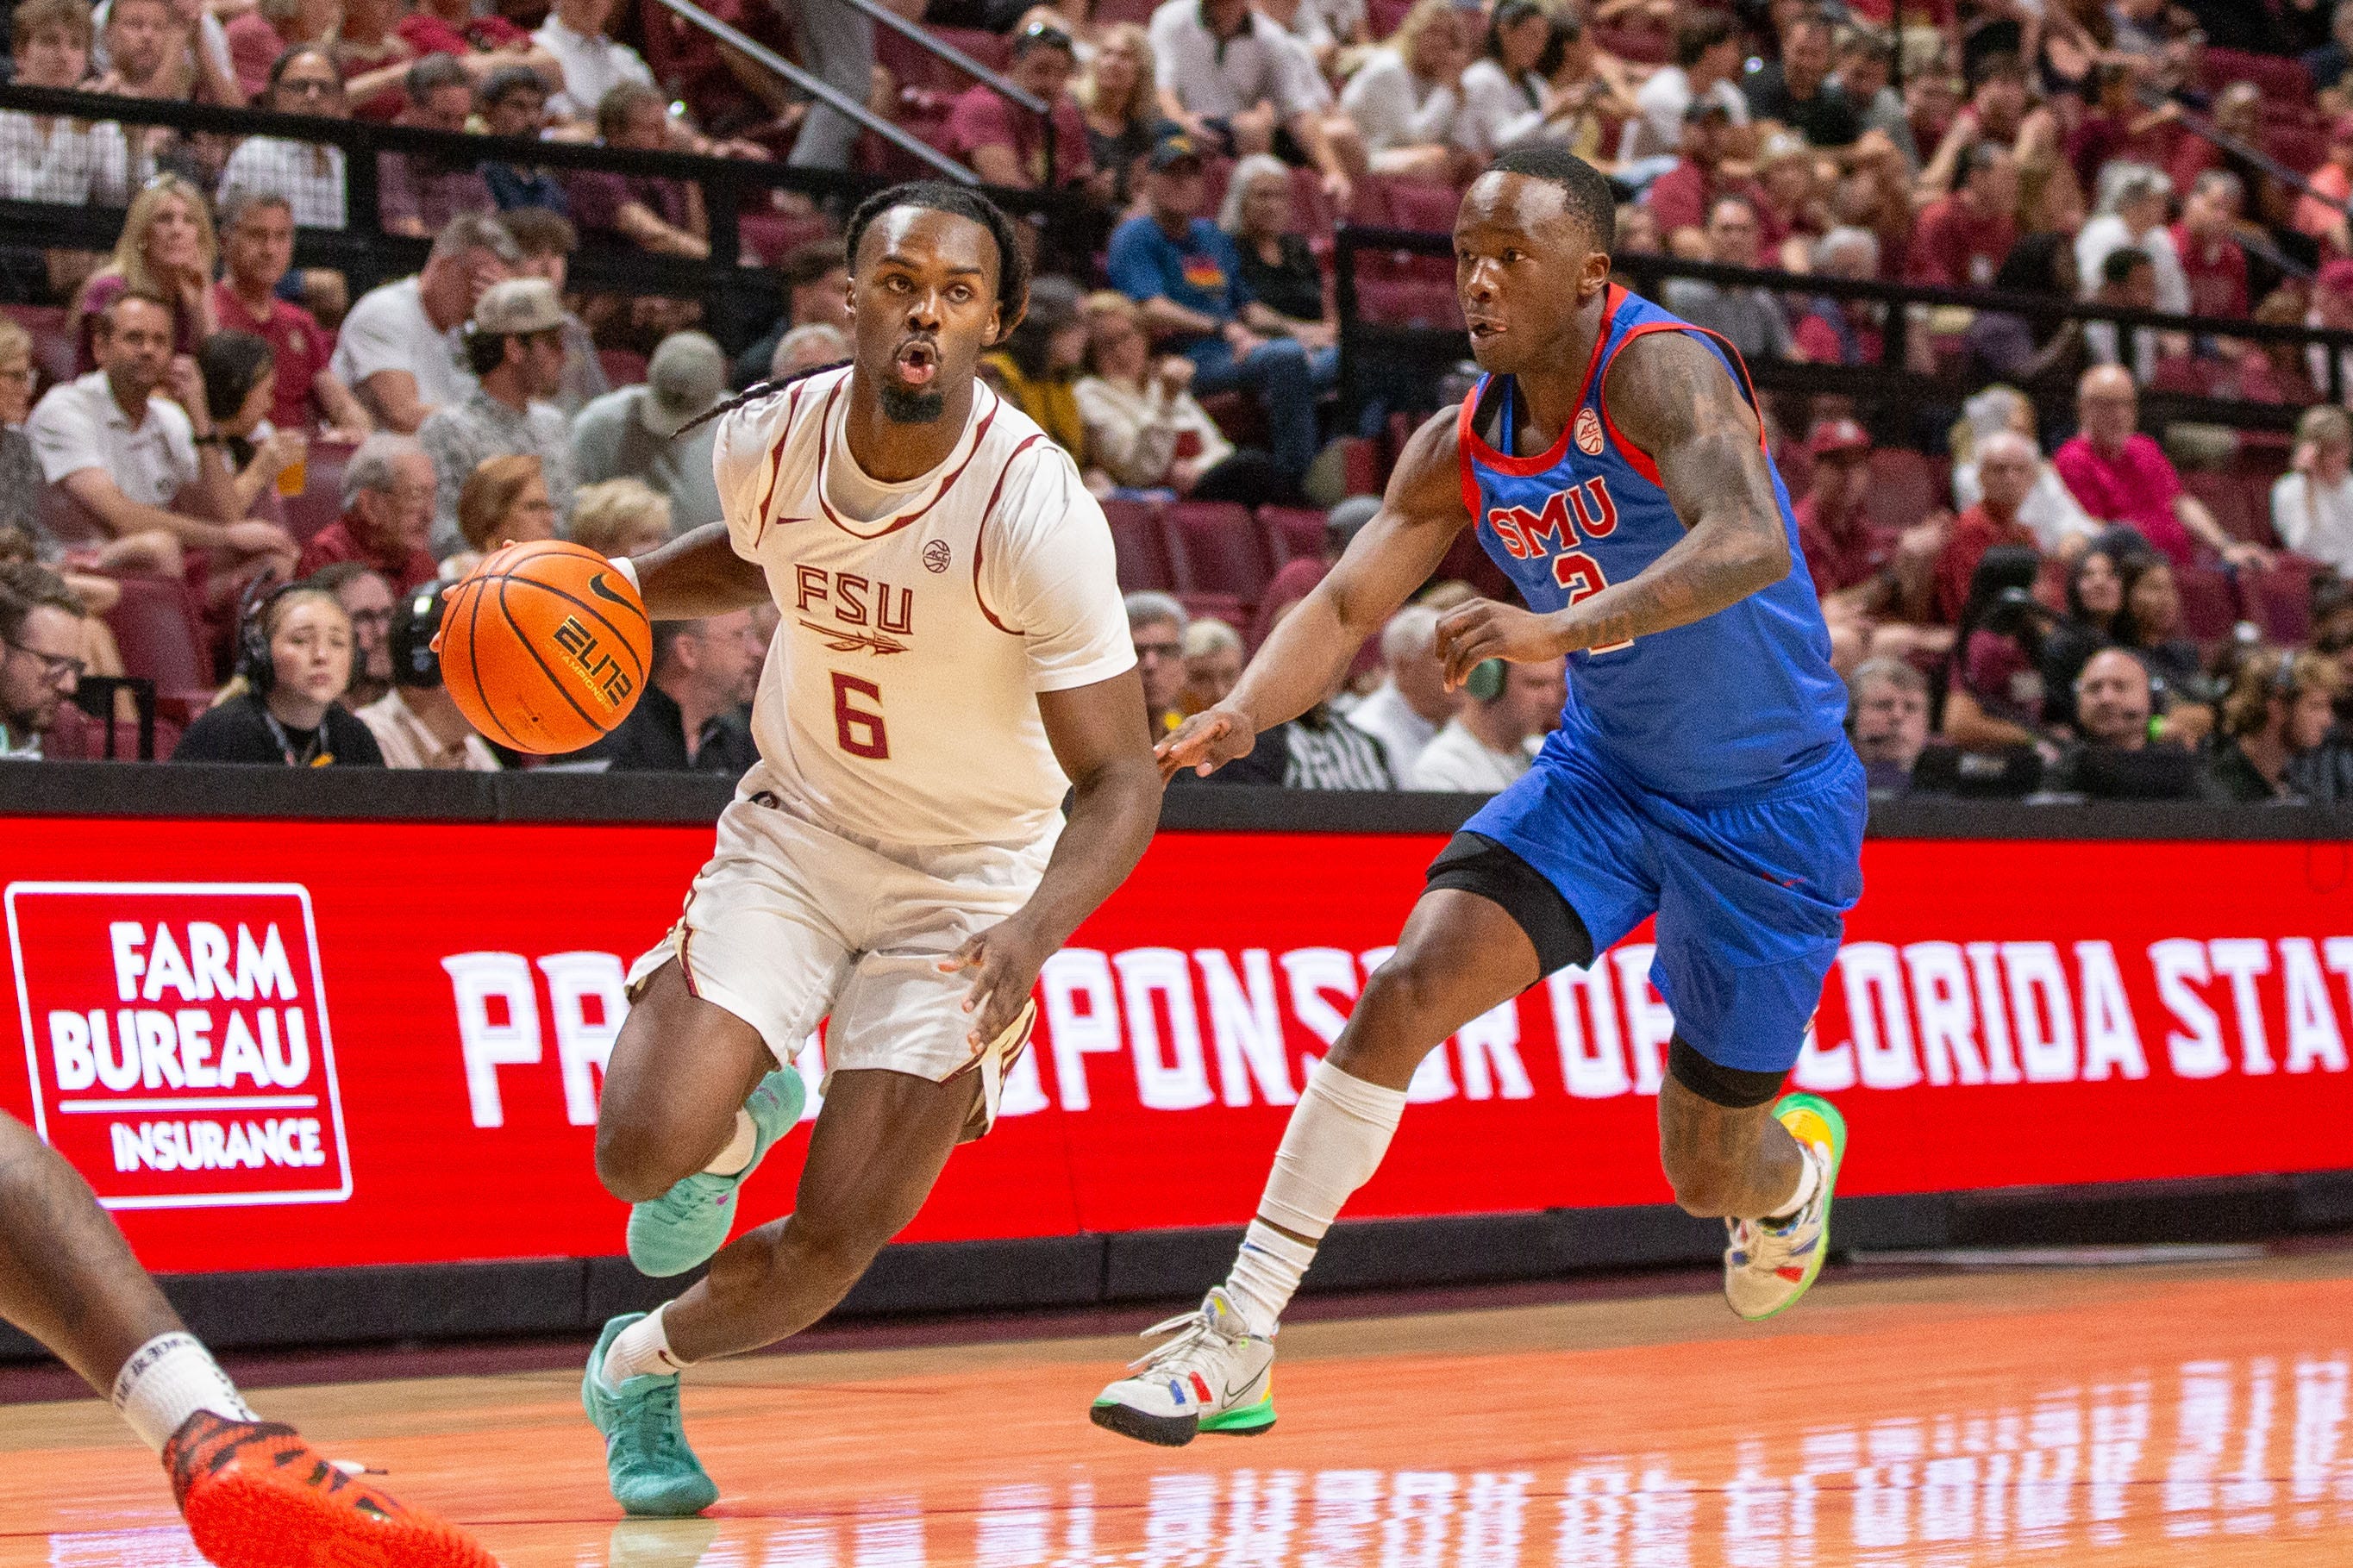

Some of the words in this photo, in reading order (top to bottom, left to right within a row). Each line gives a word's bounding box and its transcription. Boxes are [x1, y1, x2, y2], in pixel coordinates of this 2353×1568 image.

[1488, 475, 1618, 559] SMU
[794, 563, 914, 635] FSU
[1552, 551, 1635, 657] 2
[553, 614, 635, 707] ELITE
[828, 668, 892, 759] 6
[109, 921, 298, 1002] FARM
[48, 1007, 310, 1090] BUREAU
[995, 946, 1535, 1116] PONSR
[1792, 939, 2150, 1091] LORIDA
[110, 1118, 326, 1172] INSURANCE
